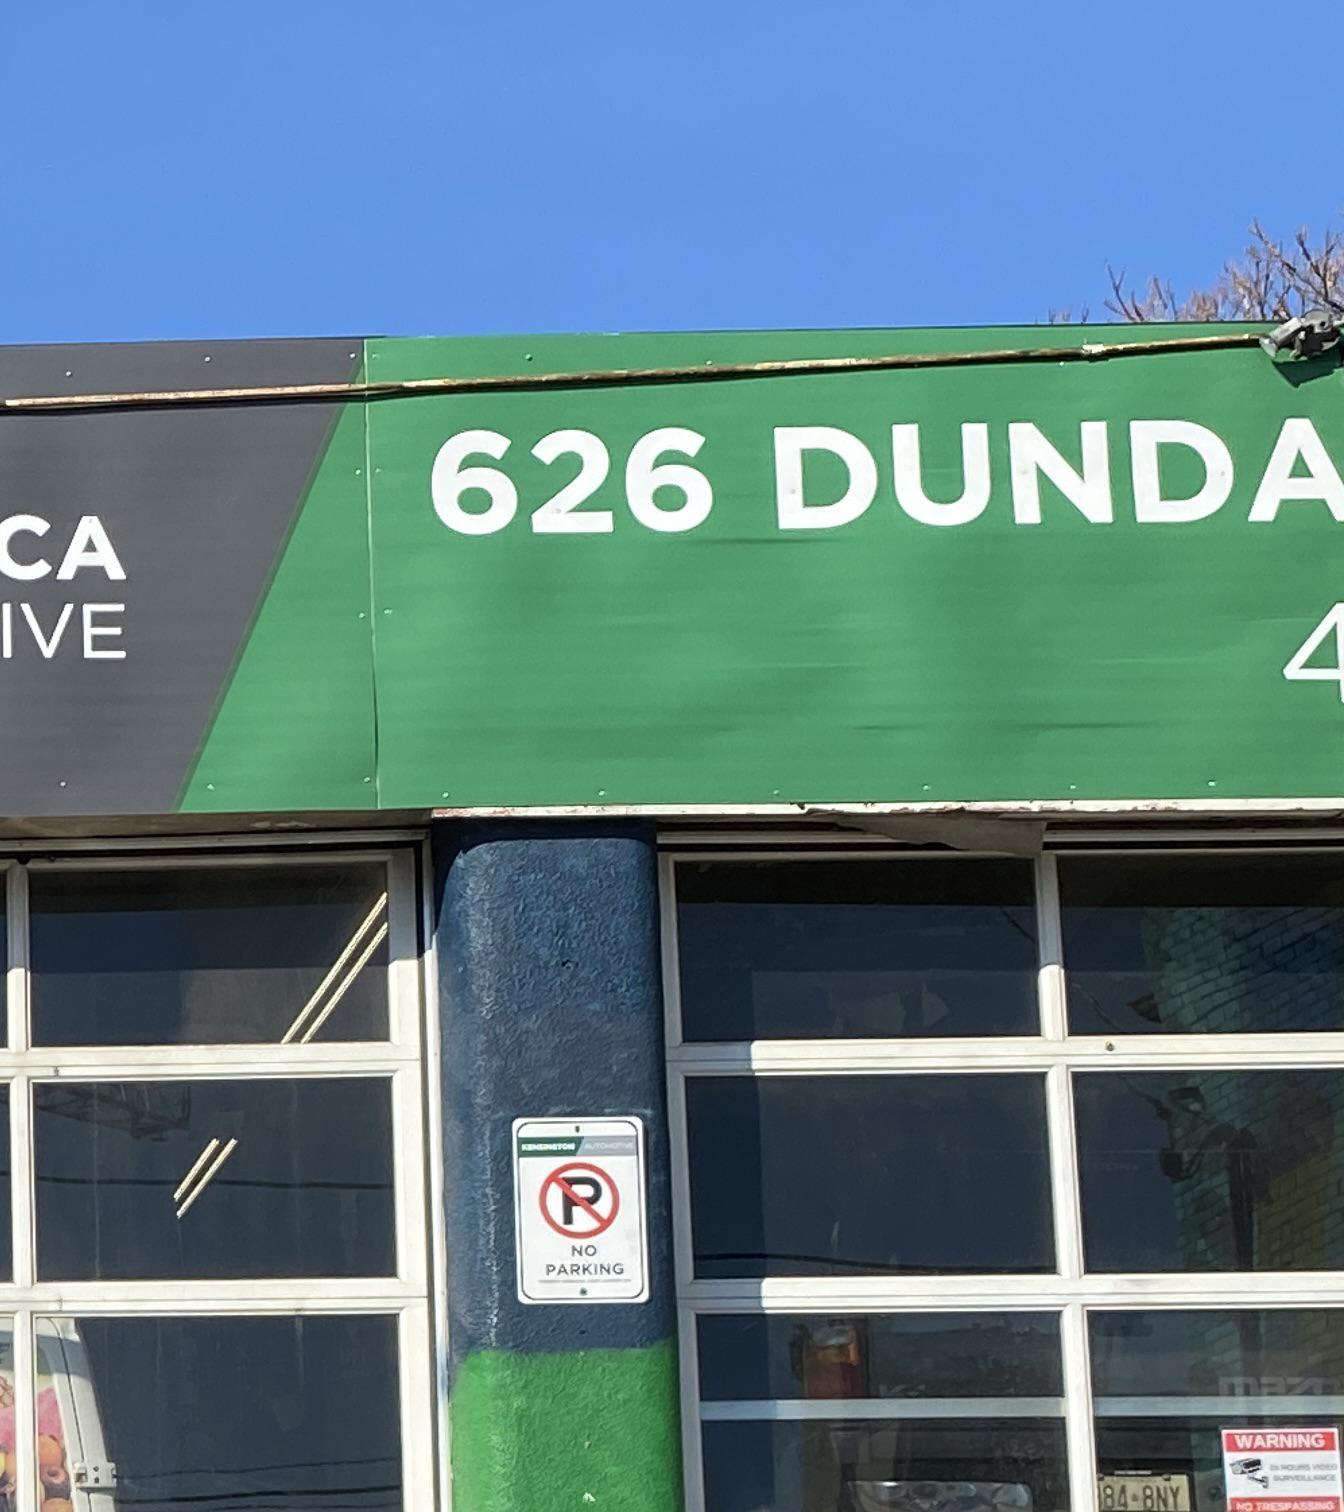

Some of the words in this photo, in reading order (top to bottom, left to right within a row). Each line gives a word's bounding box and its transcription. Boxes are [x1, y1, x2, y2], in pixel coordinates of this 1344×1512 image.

[431, 427, 713, 535] 626
[773, 418, 1344, 530] DUNDA
[571, 1245, 597, 1257] NO
[546, 1263, 624, 1276] PARKING
[1233, 1433, 1326, 1449] WARNING
